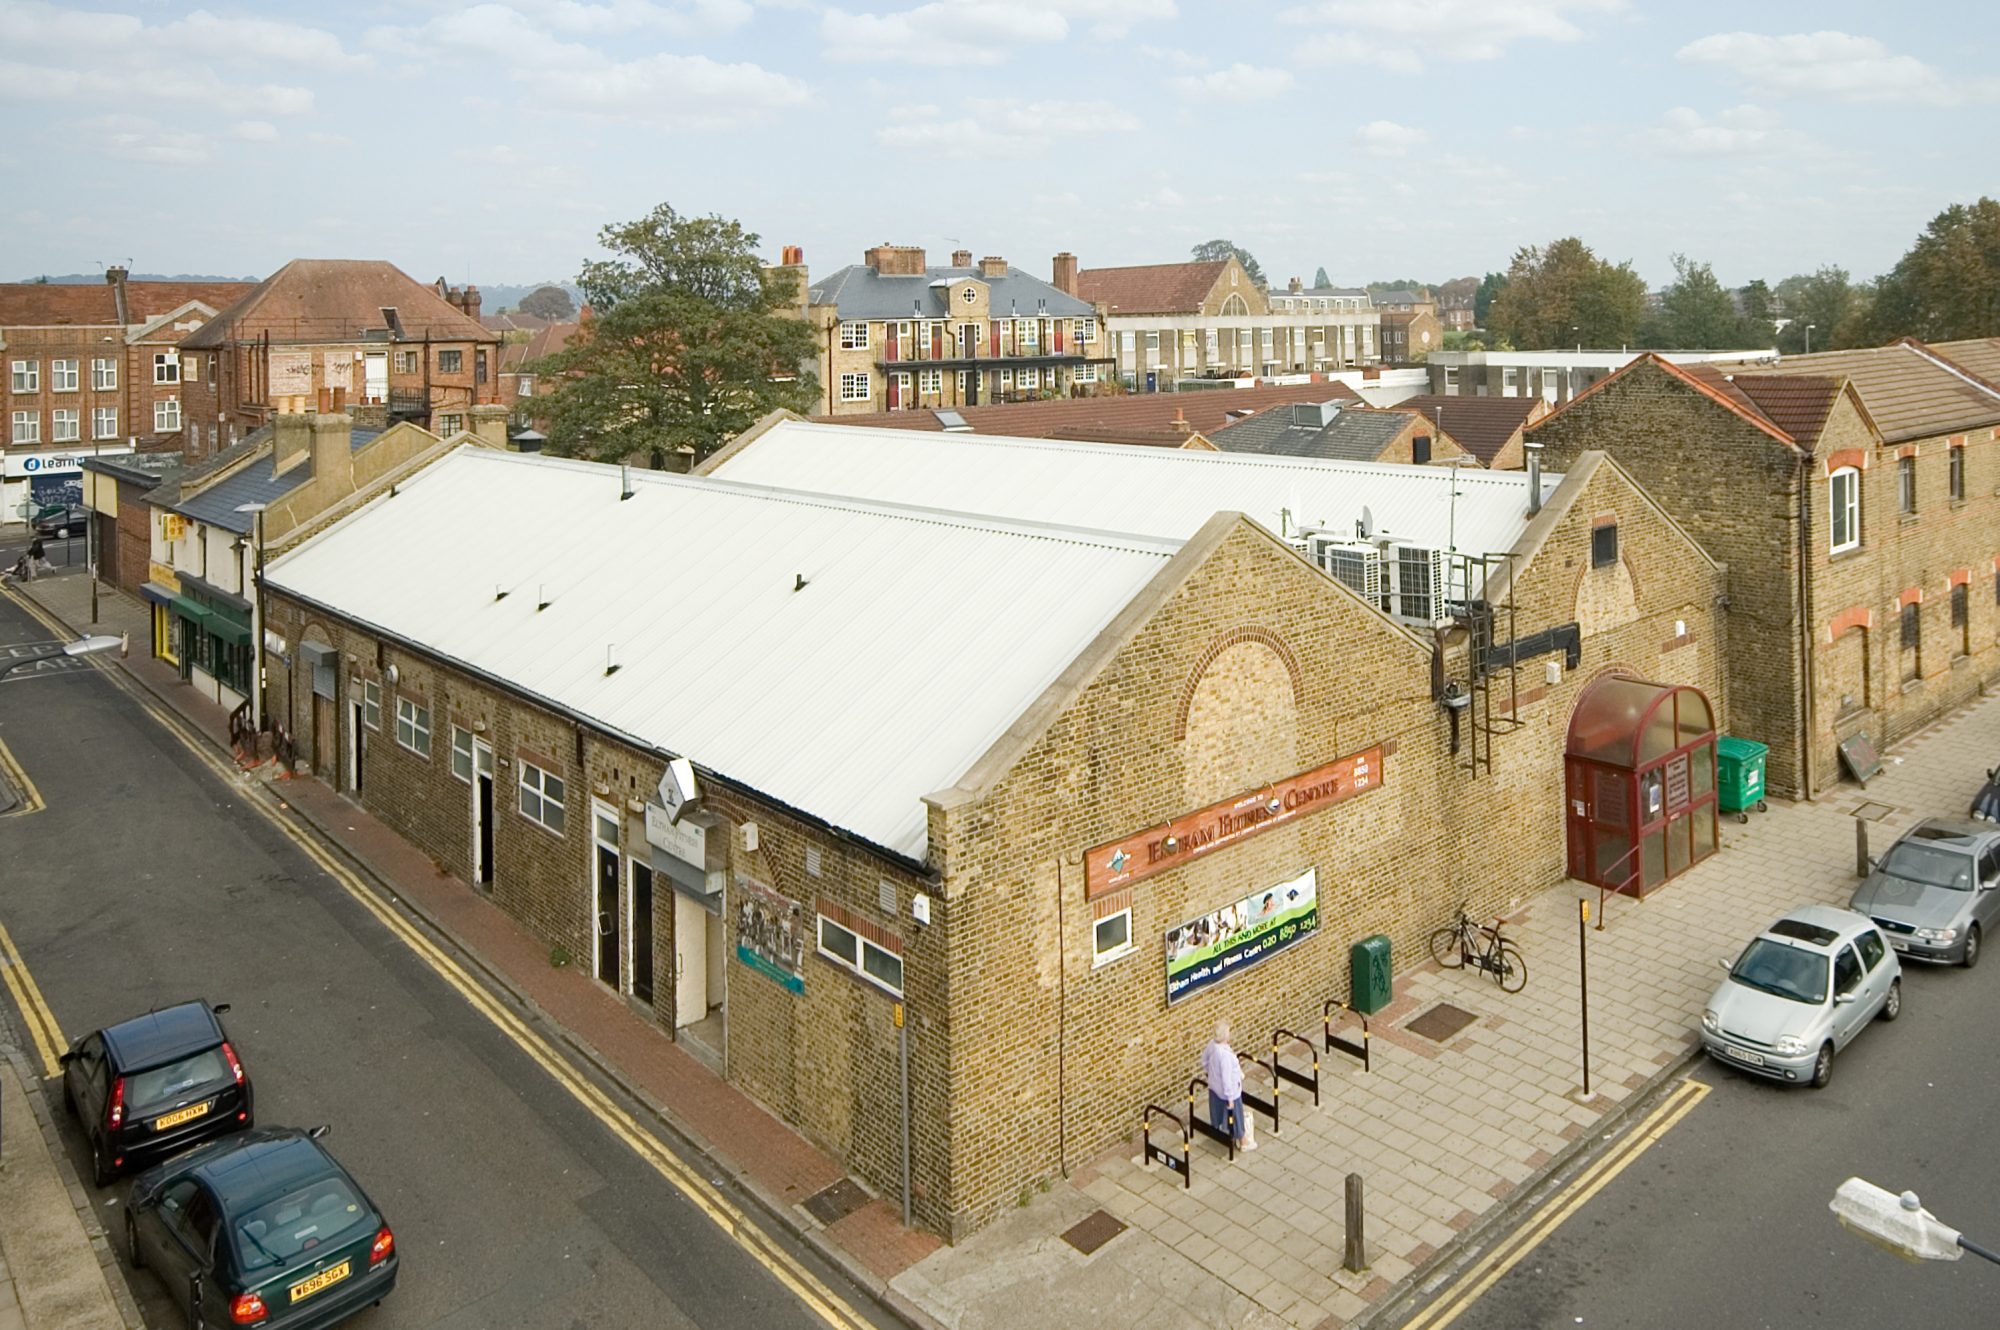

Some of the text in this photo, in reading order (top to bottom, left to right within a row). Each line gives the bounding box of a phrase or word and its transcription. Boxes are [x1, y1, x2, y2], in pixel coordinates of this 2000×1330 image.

[1283, 777, 1340, 811] CENTRE
[1353, 775, 1369, 789] 1234
[1190, 966, 1211, 983] Health
[1212, 959, 1223, 975] and
[1223, 952, 1243, 968] Fitness
[1262, 934, 1277, 949] 020
[1300, 914, 1317, 930] 1234
[1213, 916, 1277, 954] ALL THIS AND MORE AT
[295, 1265, 345, 1296] W696 SGX
